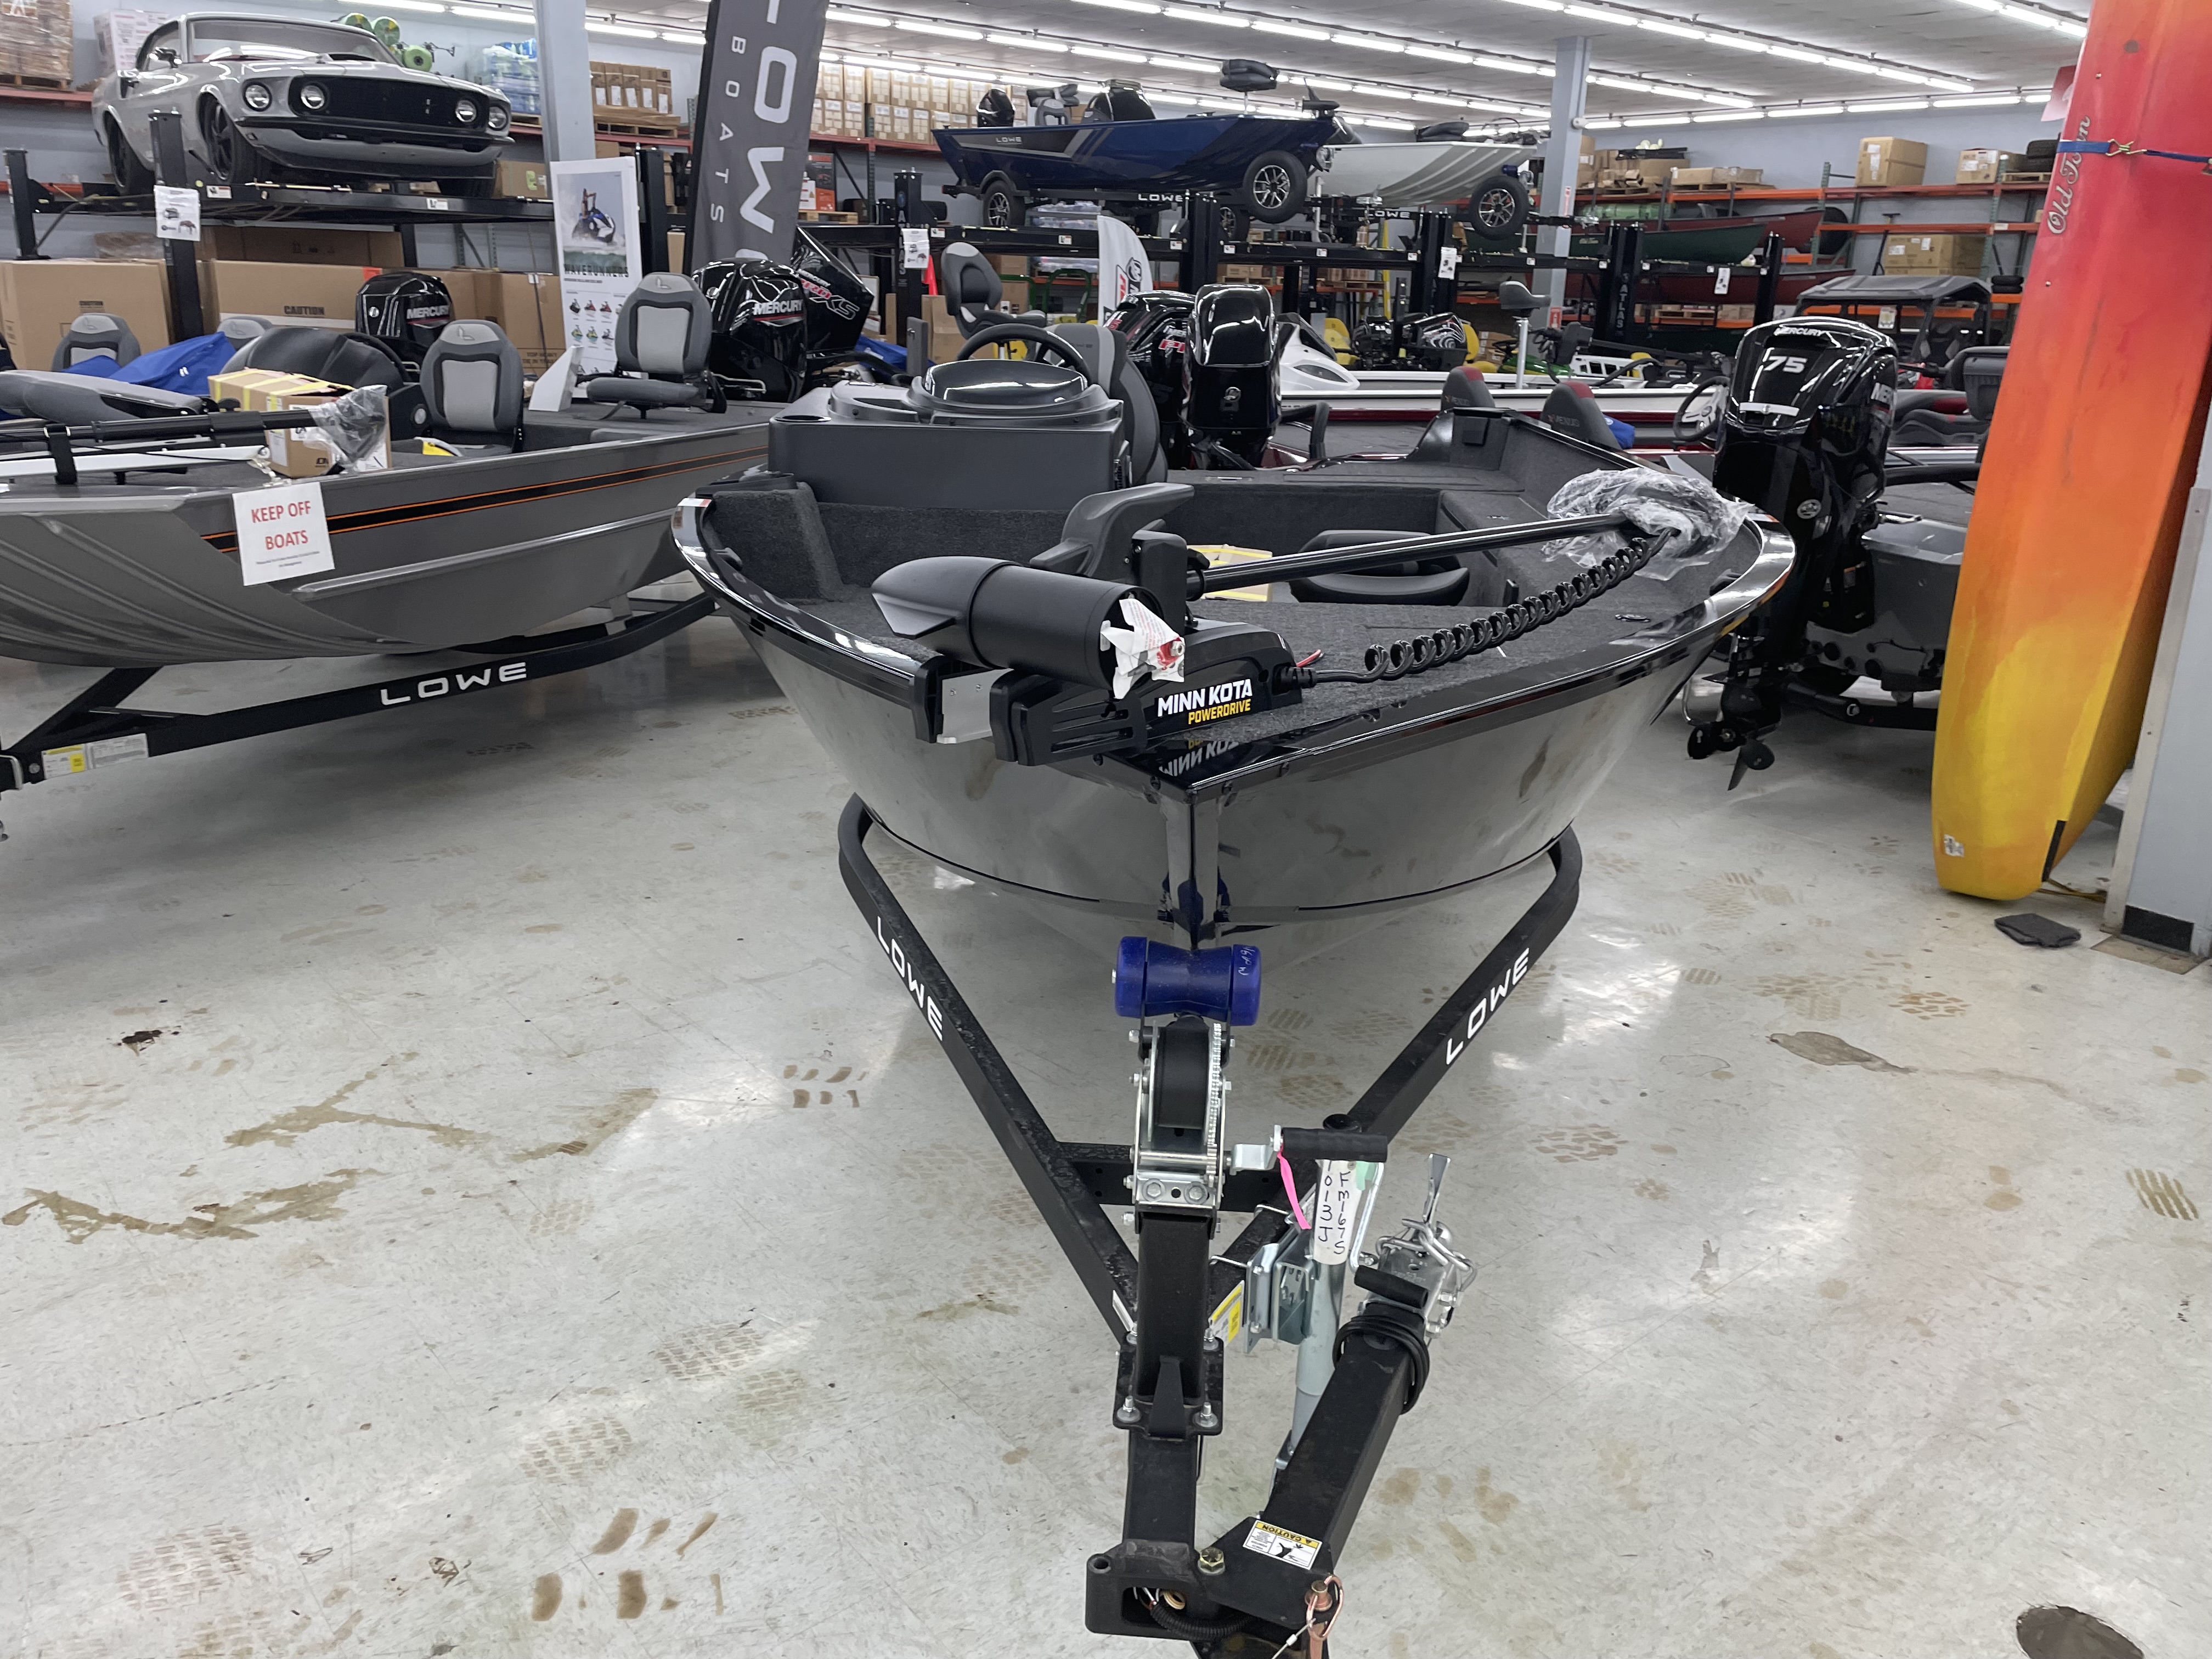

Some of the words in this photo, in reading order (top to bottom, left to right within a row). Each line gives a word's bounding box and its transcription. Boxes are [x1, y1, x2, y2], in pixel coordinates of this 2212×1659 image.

[710, 36, 747, 223] BOATS
[735, 0, 797, 258] OW
[1138, 194, 1183, 202] LOWE
[2047, 185, 2073, 234] Old
[284, 305, 325, 315] CAUTION
[752, 299, 804, 316] MERCURY
[1763, 356, 1808, 374] 75
[251, 505, 284, 523] KEEP
[287, 500, 312, 517] OFF
[264, 529, 309, 550] BOATS
[380, 662, 527, 706] LOWE
[1158, 688, 1206, 717] MINN
[1208, 679, 1253, 706] KOTA
[1188, 698, 1251, 725] POWERDRIVE
[877, 916, 944, 1041] LOWE
[1446, 947, 1530, 1065] LOWE
[1262, 1525, 1302, 1542] CAUTION
